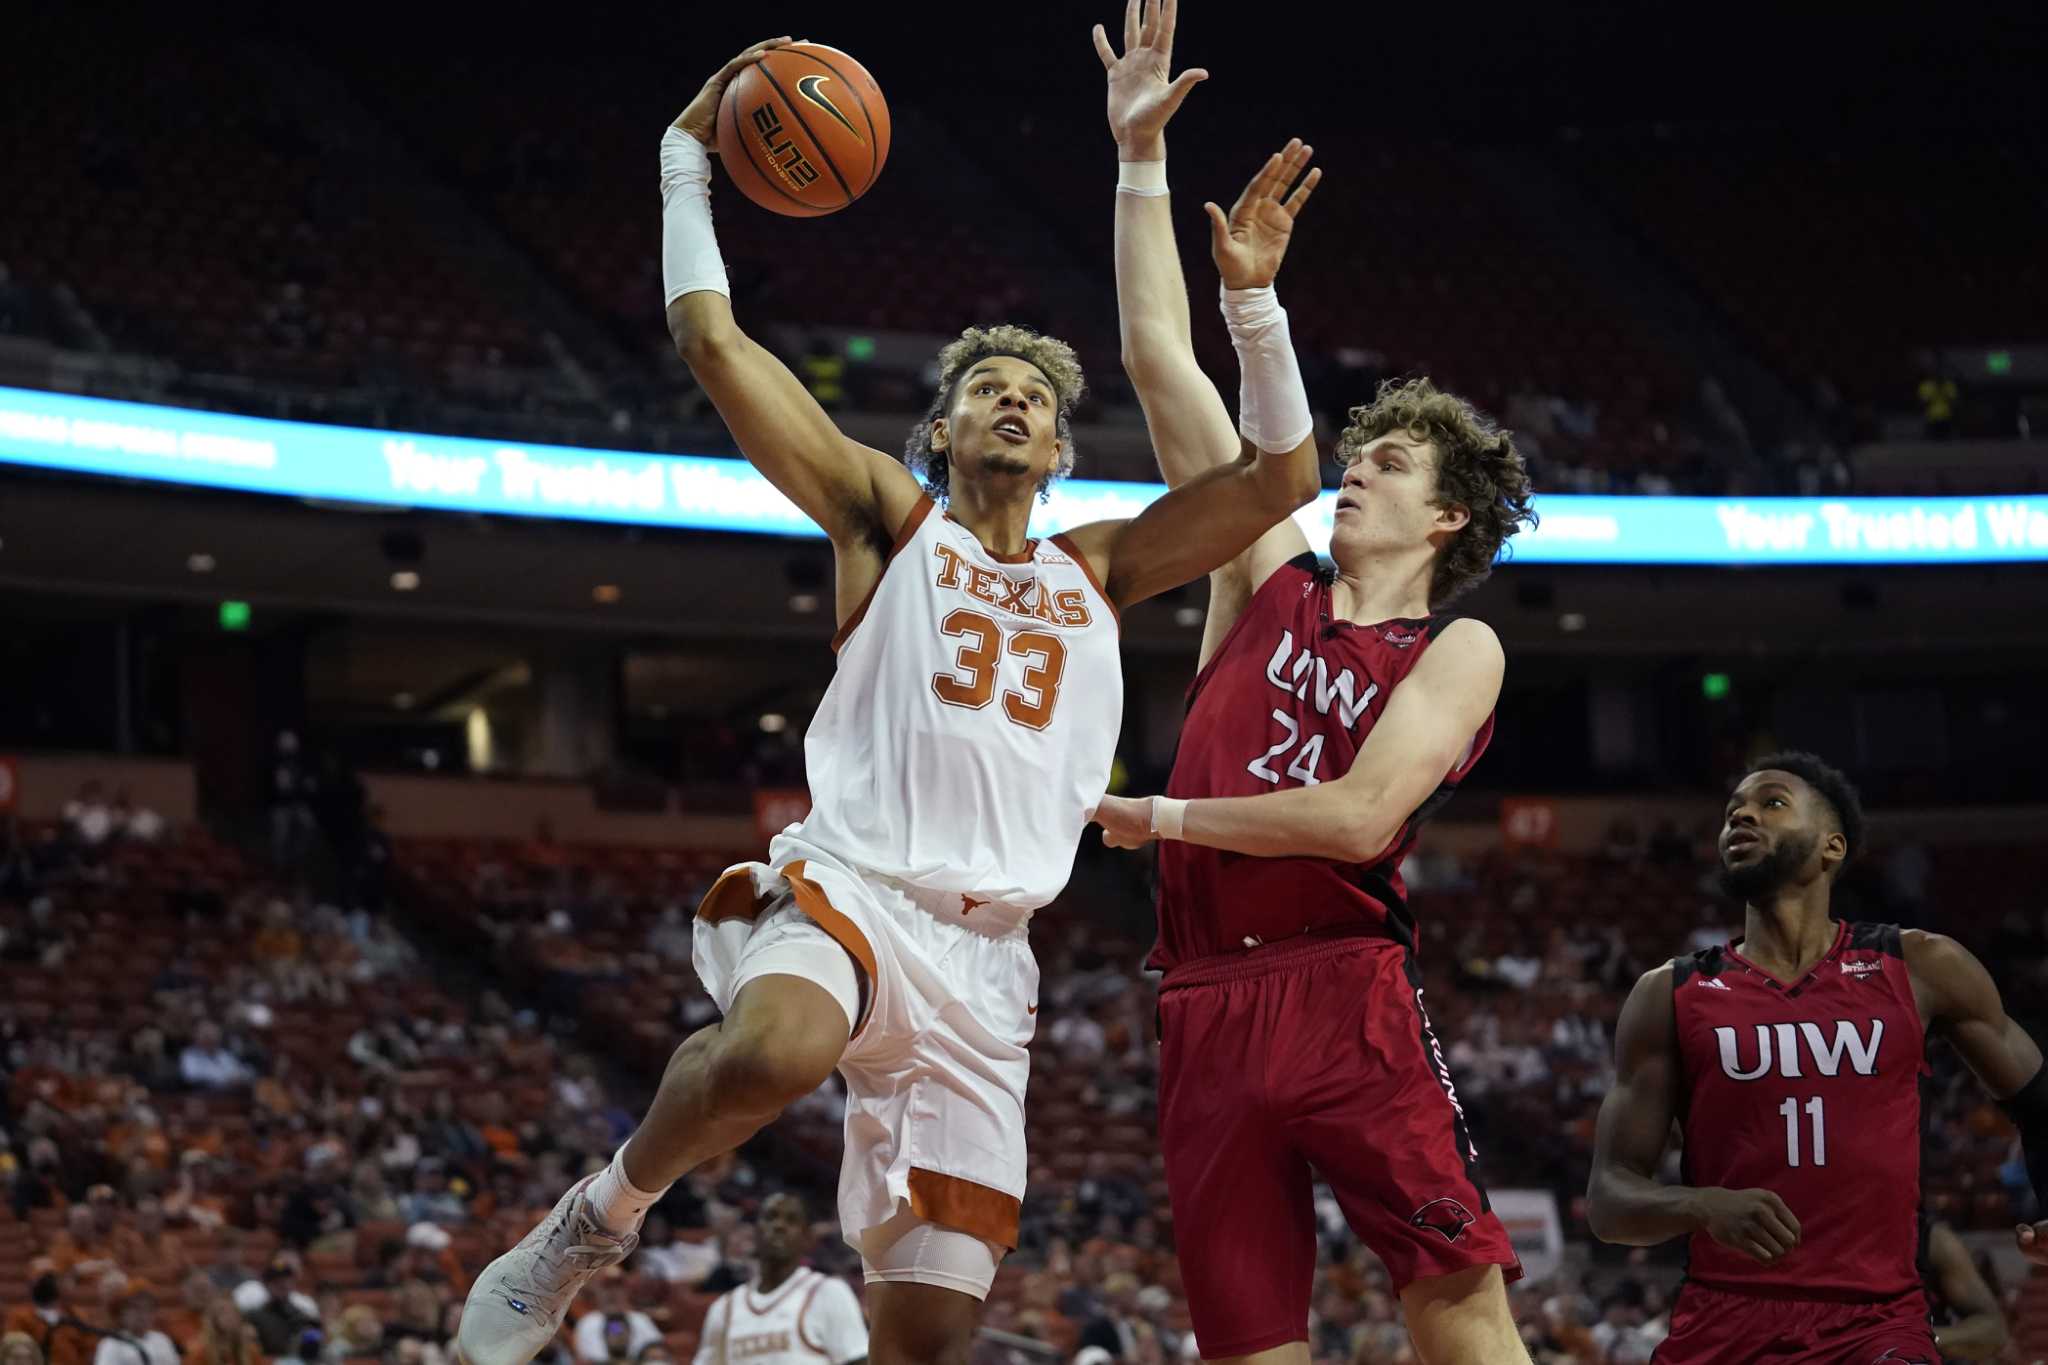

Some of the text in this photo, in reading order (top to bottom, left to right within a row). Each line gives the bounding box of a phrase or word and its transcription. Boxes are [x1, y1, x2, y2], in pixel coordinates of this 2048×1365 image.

[752, 103, 821, 188] ELITE
[384, 439, 487, 495] Your
[494, 448, 664, 508] Trusted
[1716, 503, 1814, 550] Your
[1820, 502, 1977, 550] Trusted
[934, 542, 1093, 627] TEXAS
[931, 607, 1068, 732] 33
[1266, 629, 1379, 731] UIW
[1247, 708, 1325, 786] 24
[1713, 1018, 1884, 1081] UIW
[1779, 1096, 1825, 1167] 11
